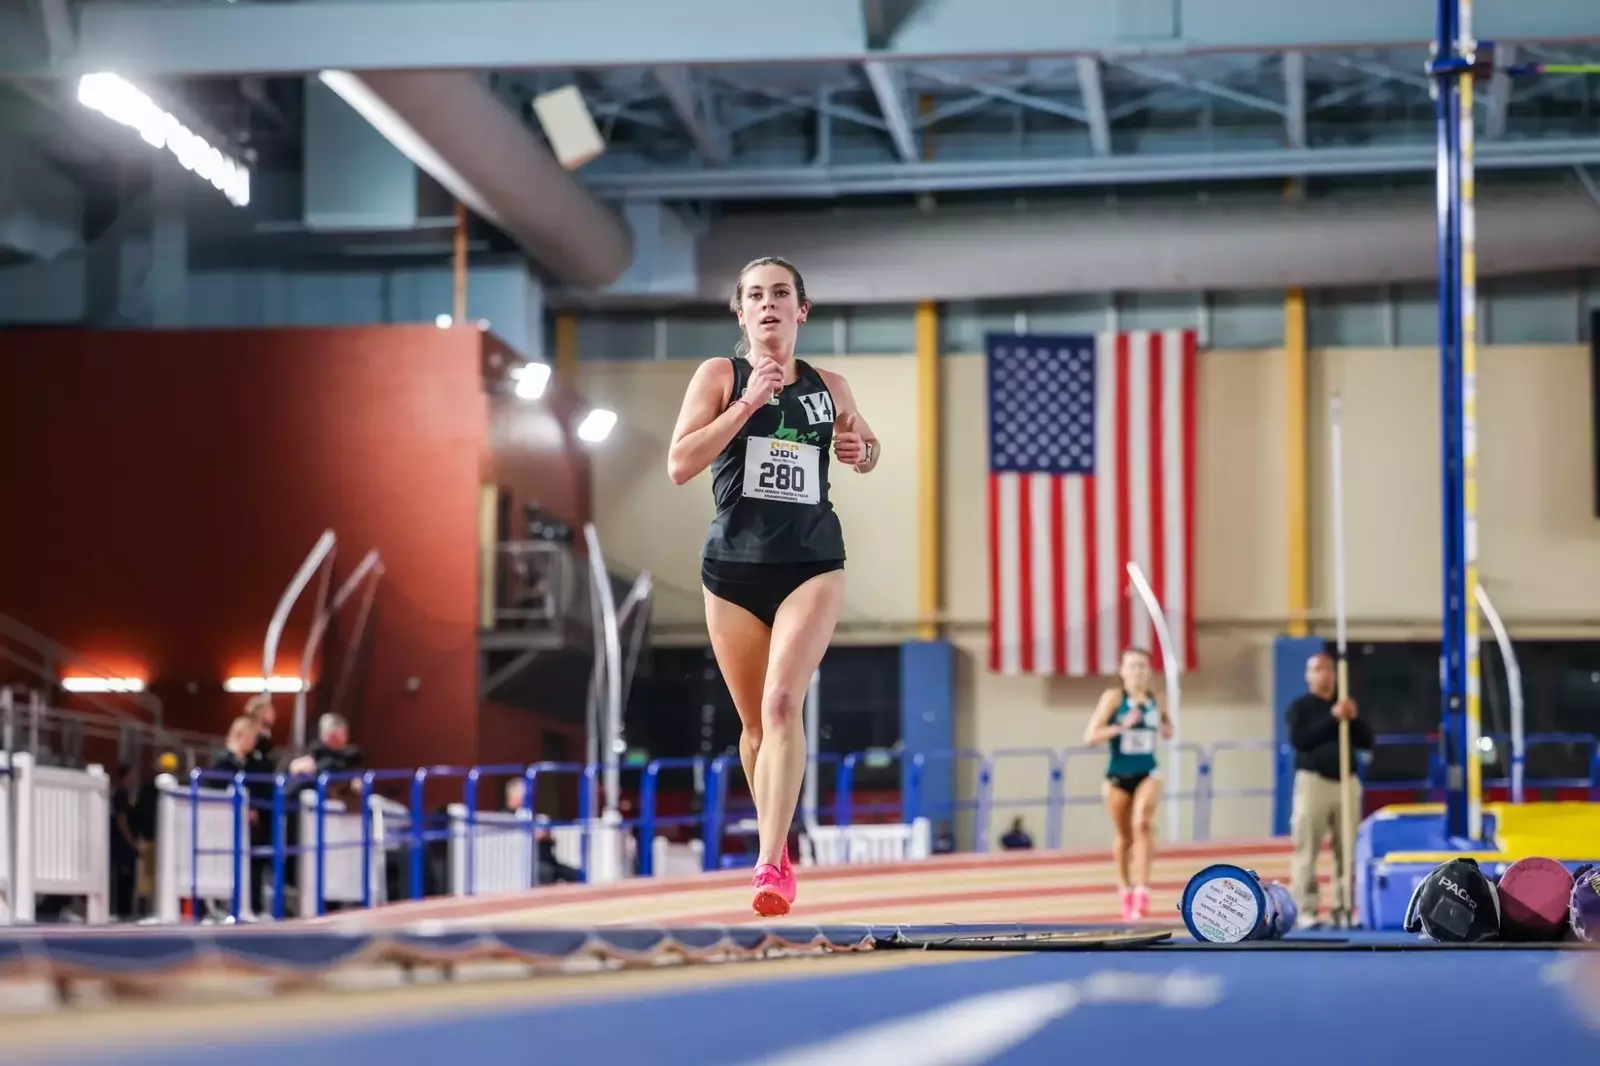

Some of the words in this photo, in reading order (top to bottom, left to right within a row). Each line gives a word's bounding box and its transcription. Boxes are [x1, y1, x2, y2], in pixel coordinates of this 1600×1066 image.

[803, 392, 831, 422] 14
[770, 441, 799, 459] SBC
[759, 462, 805, 492] 280
[764, 494, 798, 502] CHAMPIONSHIPS
[1438, 876, 1477, 909] PACER
